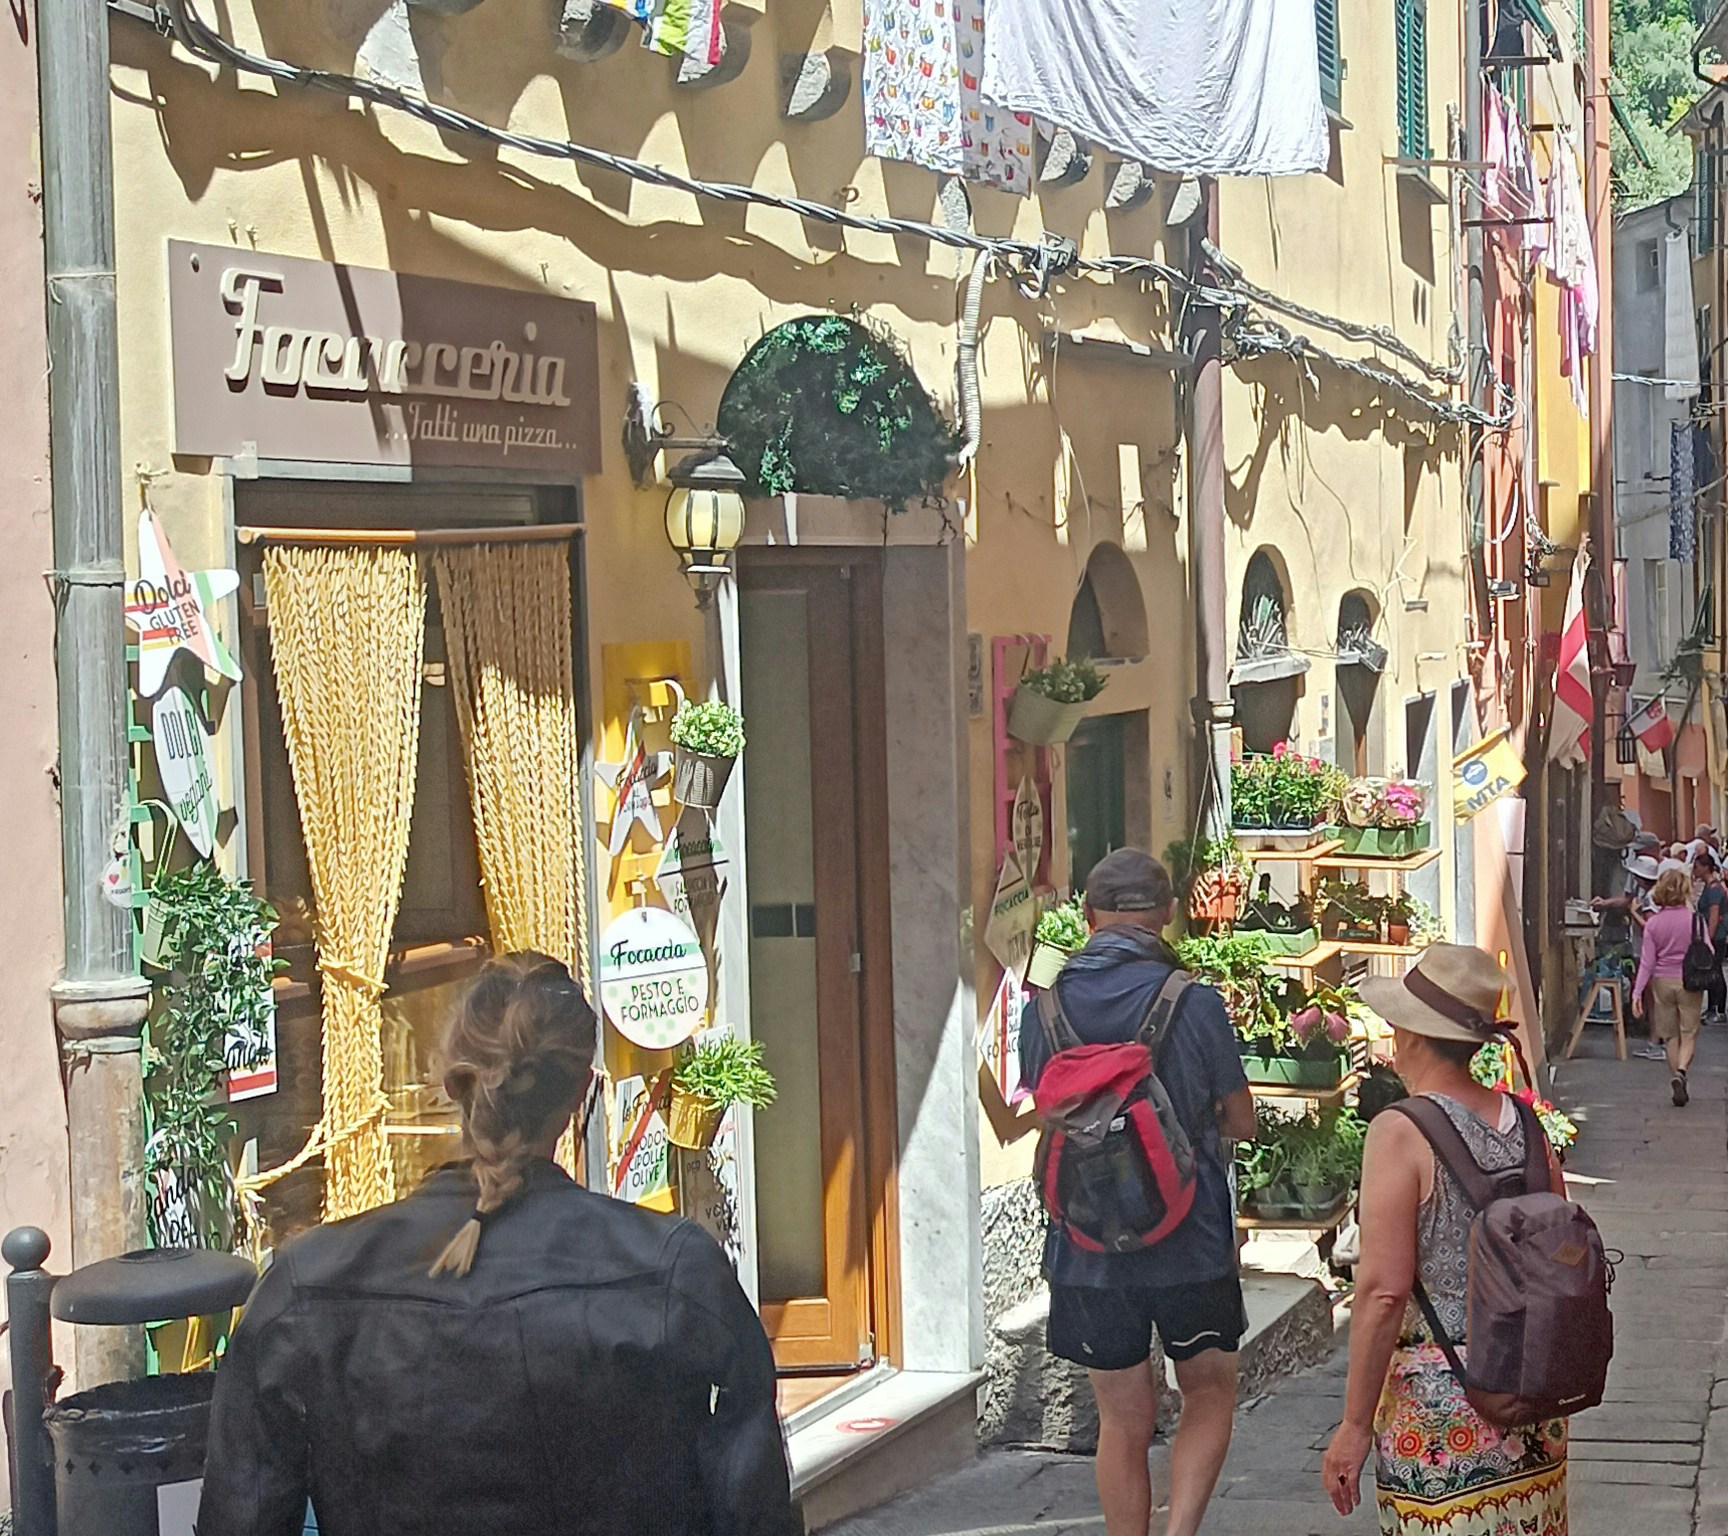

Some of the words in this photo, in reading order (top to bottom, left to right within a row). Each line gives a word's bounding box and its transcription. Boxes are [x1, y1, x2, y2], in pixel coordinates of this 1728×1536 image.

[220, 267, 571, 406] Focacceria
[462, 421, 502, 444] una
[134, 569, 192, 615] Dolci
[150, 599, 201, 631] GLUTEN
[167, 620, 199, 645] FREE
[161, 709, 204, 760] DOLCI
[610, 938, 687, 971] Focaccia
[631, 980, 672, 1001] PESTO
[677, 978, 684, 995] E
[621, 995, 699, 1024] FORMAGGIO
[629, 1146, 664, 1171] CIPOLLE
[632, 1164, 659, 1187] OLIVE
